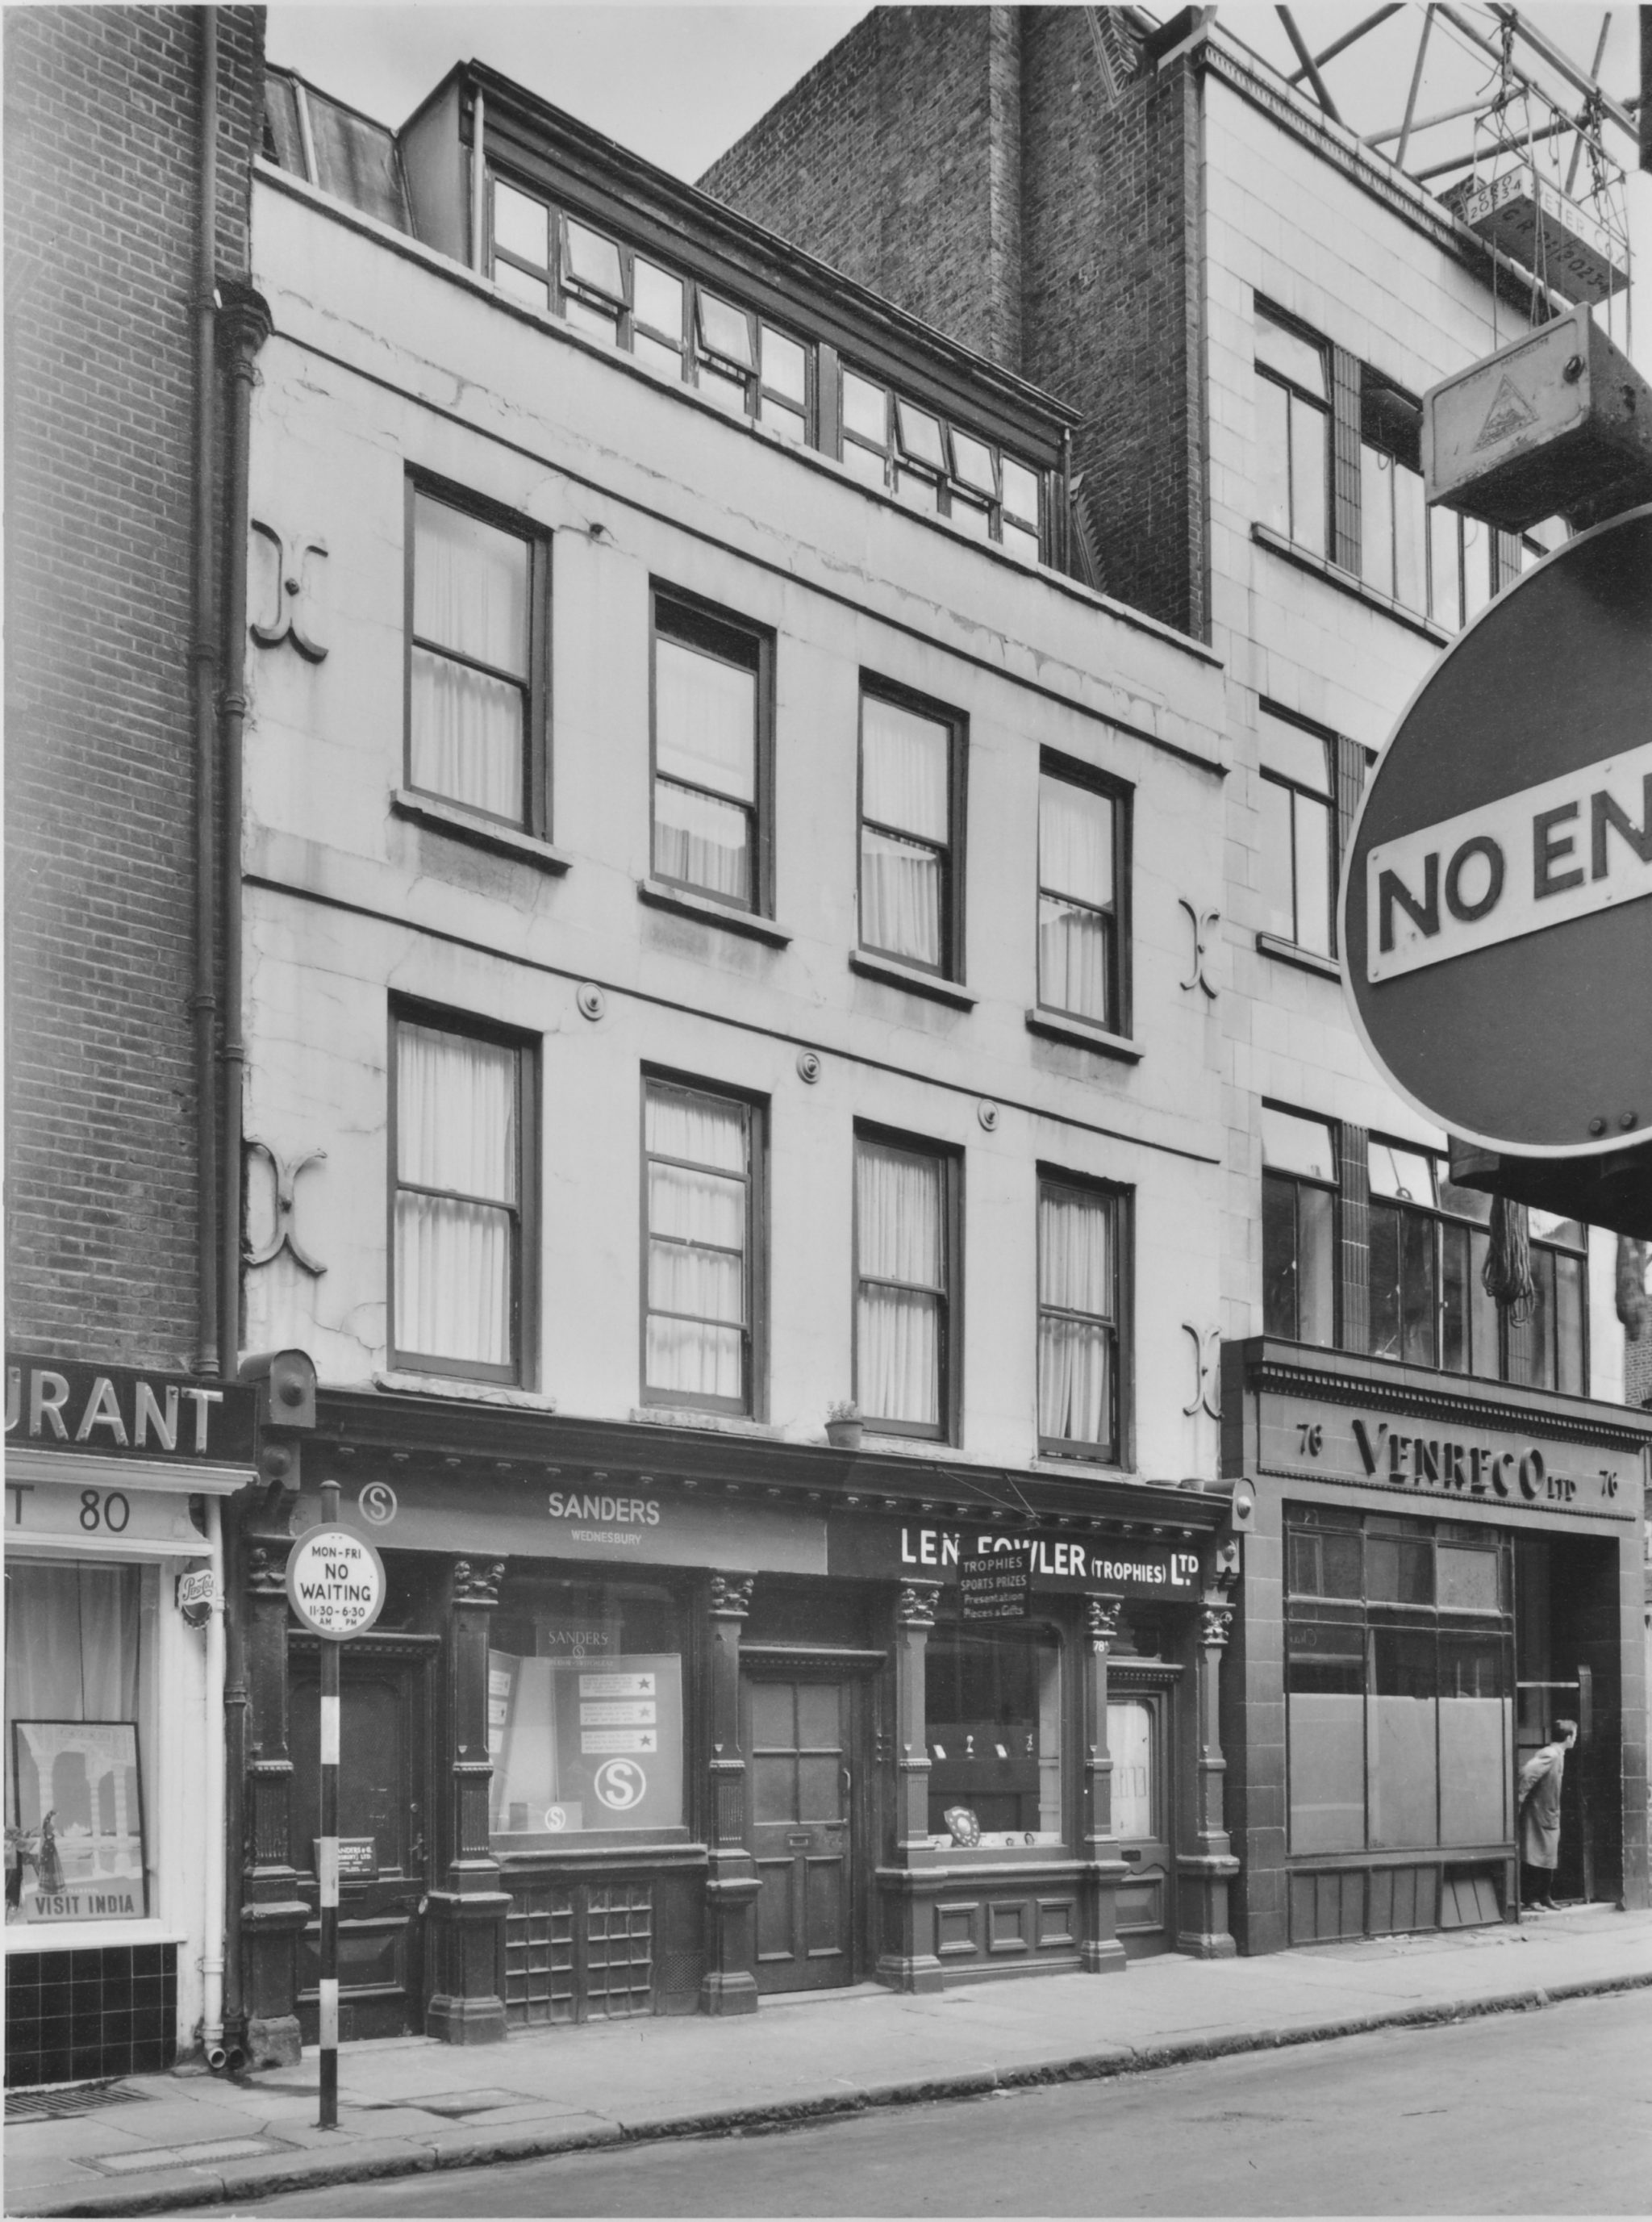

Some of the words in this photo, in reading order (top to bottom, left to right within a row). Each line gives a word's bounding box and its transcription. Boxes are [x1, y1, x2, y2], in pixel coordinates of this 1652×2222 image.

[1379, 836, 1507, 954] NO
[1296, 1422, 1324, 1458] 76
[1352, 1418, 1546, 1501] VENRECO
[1547, 1476, 1576, 1502] LTD
[1599, 1470, 1618, 1498] 76
[79, 1489, 130, 1533] 80
[548, 1492, 661, 1526] SANDERS
[570, 1528, 642, 1546] WEDNESBURY
[901, 1527, 961, 1566] LEN
[1091, 1556, 1166, 1584] (TROPHIES)
[963, 1556, 1023, 1573] TROPHIES
[325, 1562, 348, 1581] NO
[299, 1582, 371, 1602] WAITING
[961, 1577, 995, 1591] SPORTS
[996, 1574, 1027, 1589] PRIZES
[964, 1592, 1025, 1605] Presentation
[319, 1618, 332, 1626] AM
[345, 1618, 357, 1626] PM
[549, 1631, 608, 1646] SANDERS
[35, 1896, 80, 1916] VISIT
[88, 1894, 135, 1915] INDIA
